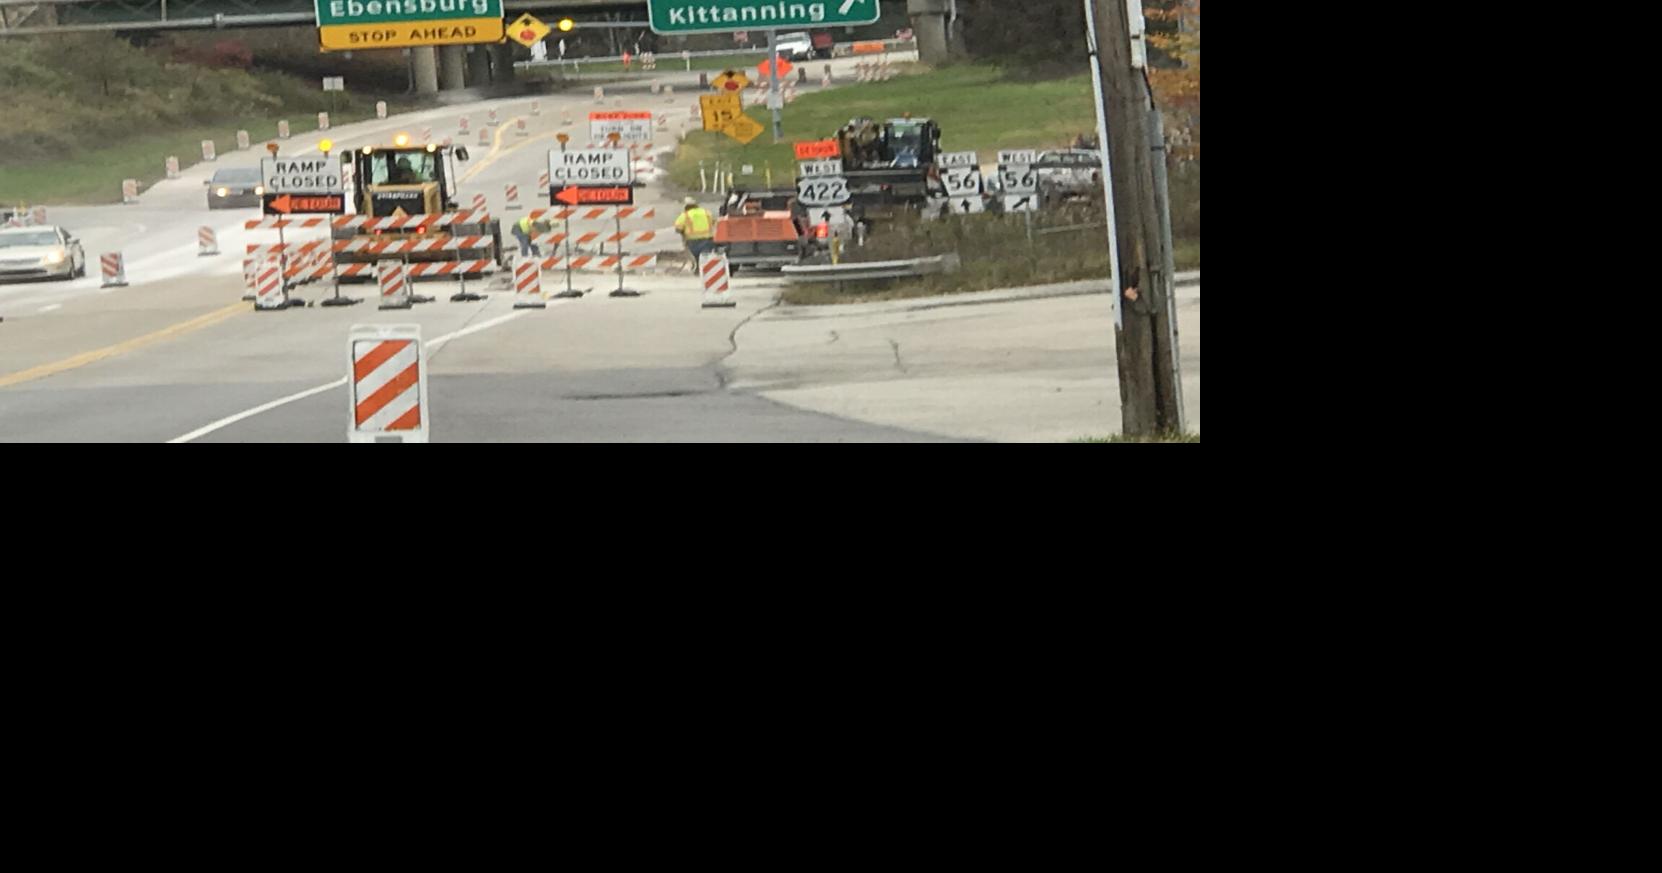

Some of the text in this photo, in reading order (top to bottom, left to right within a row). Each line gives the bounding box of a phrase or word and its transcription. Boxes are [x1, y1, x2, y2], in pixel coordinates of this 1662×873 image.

[330, 0, 489, 17] Ebensburg
[669, 1, 826, 24] Kittanning
[349, 26, 477, 43] STOP AHEAD
[564, 153, 614, 165] RAMP
[1002, 153, 1032, 162] WEST
[276, 161, 327, 174] RAMP
[555, 167, 624, 180] CLOSED
[804, 163, 837, 173] WEST
[269, 175, 338, 189] CLOSED
[948, 172, 976, 190] 56
[1005, 171, 1034, 188] 56
[803, 181, 844, 200] 422
